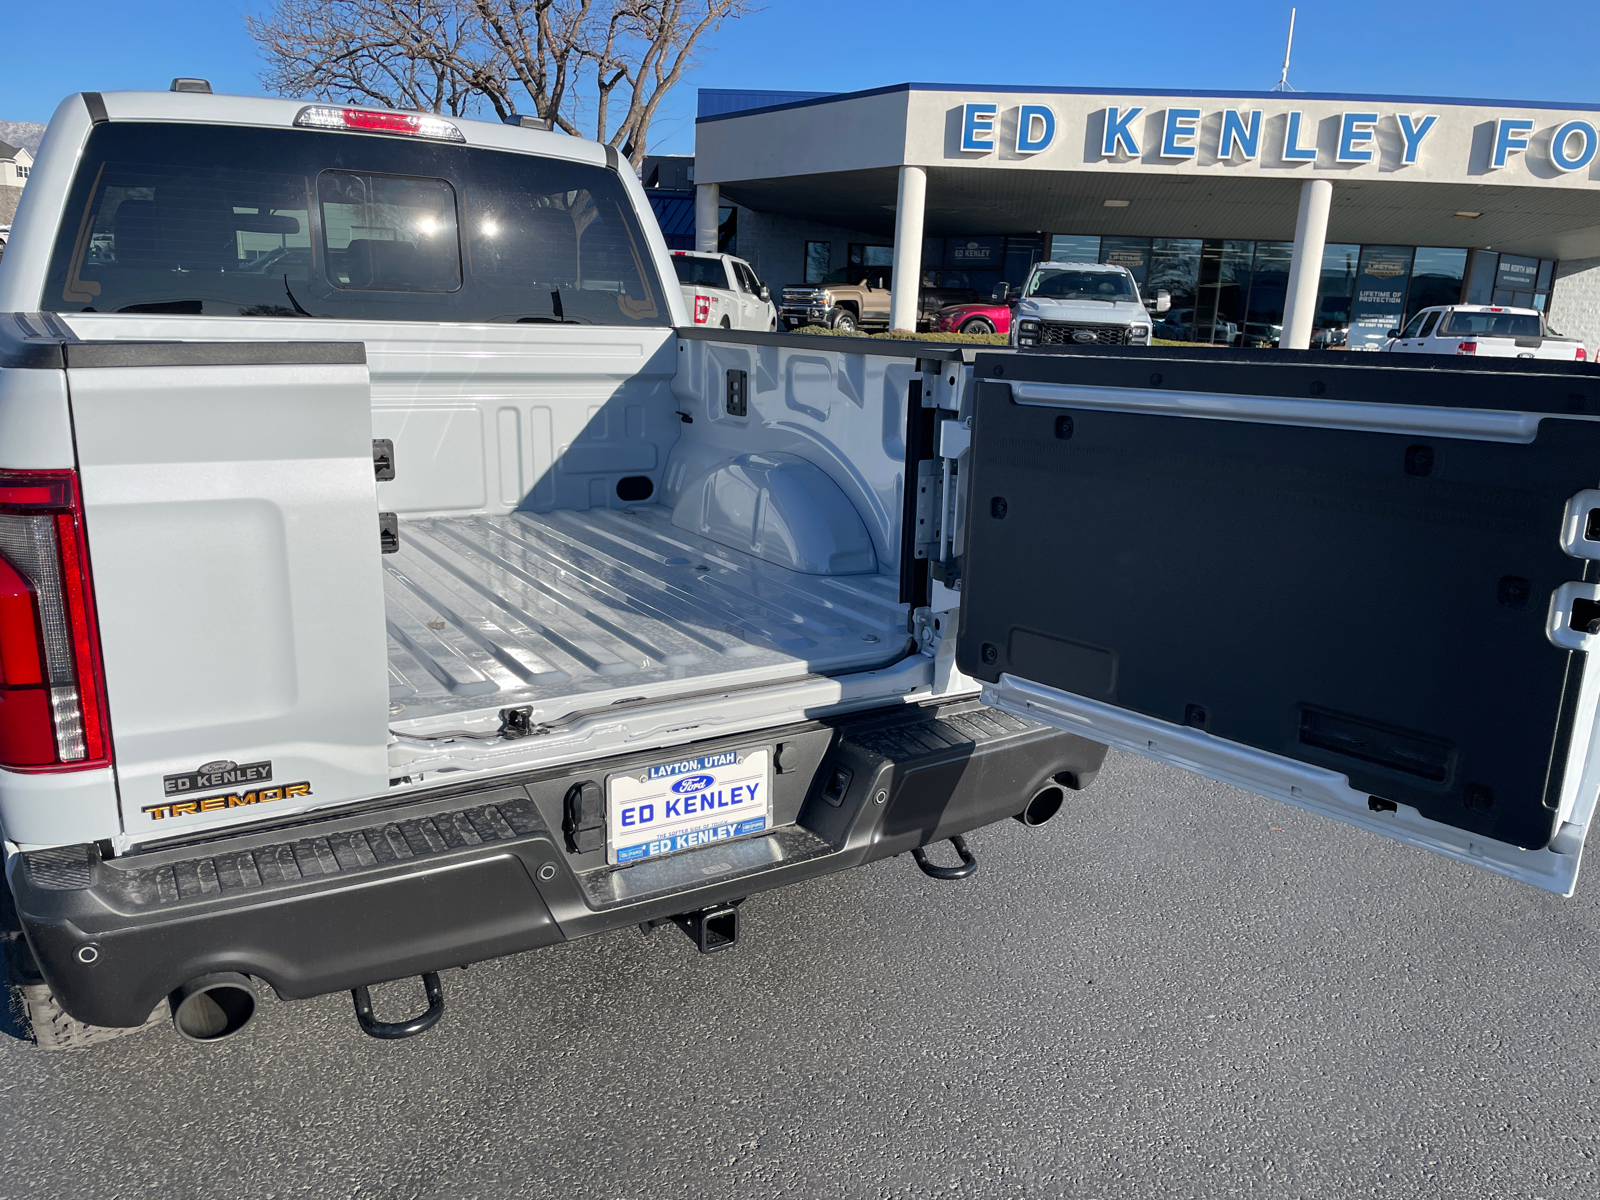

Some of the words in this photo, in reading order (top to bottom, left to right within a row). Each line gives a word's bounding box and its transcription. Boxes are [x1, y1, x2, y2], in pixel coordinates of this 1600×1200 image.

[960, 102, 1057, 154] ED
[1101, 106, 1440, 165] KENLEY
[165, 778, 190, 792] ED
[198, 765, 270, 788] KENLEY
[207, 763, 228, 773] Ford
[651, 759, 701, 778] LAYTON,
[704, 752, 735, 768] UTAH
[679, 777, 707, 793] Ford
[141, 781, 313, 820] TREMOR
[621, 804, 654, 827] ED
[665, 782, 760, 818] KENLEY
[650, 839, 671, 855] ED
[676, 823, 738, 849] KENLEY
[668, 828, 689, 836] SOFTER
